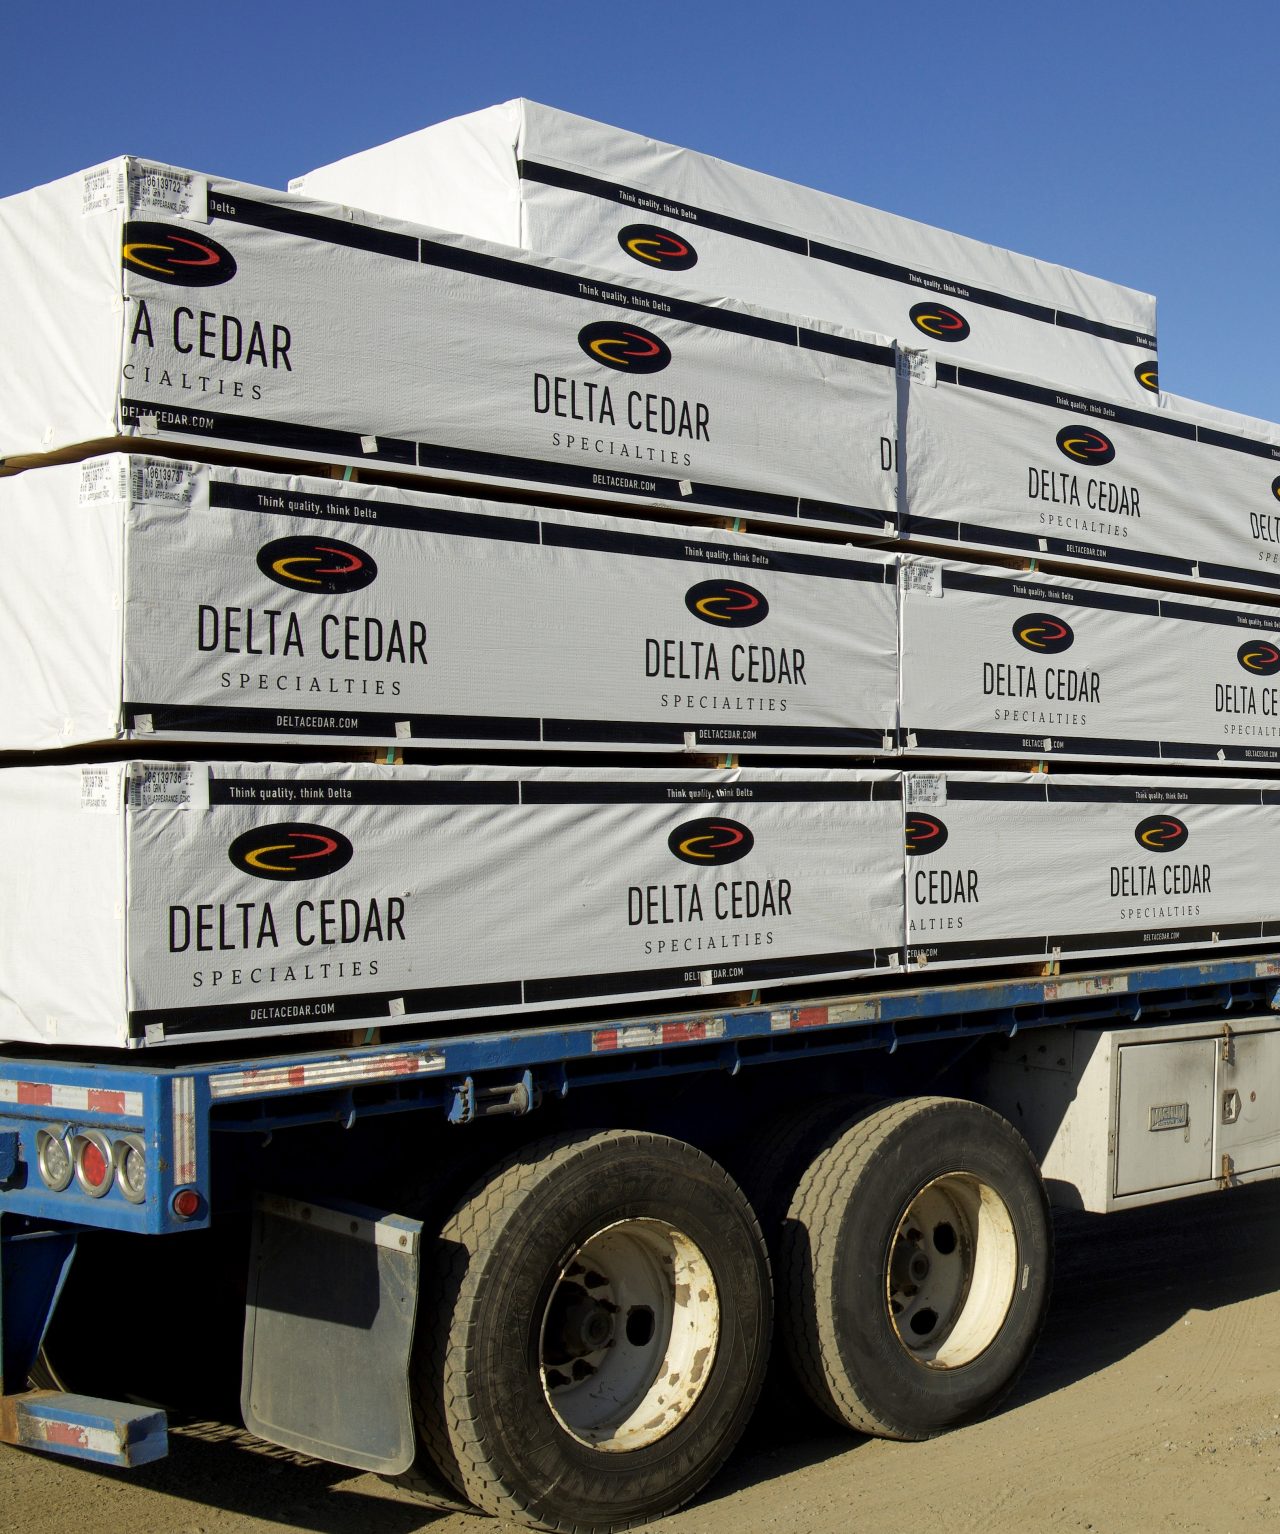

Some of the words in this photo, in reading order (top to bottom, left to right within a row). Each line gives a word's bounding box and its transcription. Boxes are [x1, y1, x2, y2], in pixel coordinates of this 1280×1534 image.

[210, 200, 236, 215] Delta
[619, 190, 636, 202] Think
[638, 198, 661, 211] quality,
[664, 205, 679, 216] think
[681, 208, 697, 220] Delta
[909, 274, 922, 284] Think
[923, 279, 942, 291] quality,
[943, 283, 955, 293] think
[957, 287, 969, 297] Delta
[579, 283, 599, 296] Think
[602, 289, 629, 303] quality,
[631, 298, 650, 308] think
[652, 300, 671, 312] Delta
[173, 307, 292, 371] CEDAR
[1136, 336, 1148, 344] Think
[534, 373, 615, 425] DELTA
[628, 391, 709, 441] CEDAR
[1056, 396, 1069, 406] Think
[1070, 401, 1088, 412] quality,
[1090, 405, 1101, 413] think
[1103, 409, 1115, 417] Delta
[552, 432, 691, 466] SPECIALTIES
[1271, 449, 1280, 458] Think
[593, 474, 656, 491] DELTACEDAR.COM
[1028, 467, 1080, 506] DELTA
[1087, 478, 1140, 517] CEDAR
[155, 490, 180, 501] APPEARANCE
[258, 495, 284, 508] Think
[289, 498, 323, 515] quality,
[327, 504, 350, 516] think
[354, 507, 377, 519] Delta
[1040, 513, 1128, 537] SPECIALTIES
[685, 547, 704, 556] Think
[706, 550, 730, 561] quality,
[733, 553, 750, 562] think
[752, 555, 768, 565] Delta
[1067, 544, 1106, 558] DELTACEDAR.COM
[1013, 585, 1027, 594] Think
[1029, 587, 1046, 598] quality,
[1048, 589, 1060, 599] think
[1061, 592, 1073, 600] Delta
[1237, 616, 1247, 624] Think
[198, 605, 304, 657] DELTA
[321, 614, 427, 664] CEDAR
[646, 638, 720, 680] DELTA
[732, 644, 806, 685] CEDAR
[221, 673, 401, 695] SPECIALTIES
[983, 662, 1037, 698] DELTA
[1045, 668, 1100, 703] CEDAR
[661, 694, 787, 711] SPECIALTIES
[1216, 684, 1256, 715] DELTA
[277, 716, 358, 728] DELTACEDAR.COM
[995, 709, 1086, 726] SPECIALTIES
[699, 729, 756, 739] DELTACEDAR.COM
[1245, 750, 1277, 758] DELTACEDAR.COM
[153, 795, 178, 804] APPEARANCE
[230, 787, 255, 798] Think
[260, 787, 297, 800] quality,
[300, 787, 324, 798] think
[328, 788, 352, 798] Delta
[667, 789, 686, 798] Think
[689, 789, 715, 799] quality,
[716, 789, 733, 797] think
[736, 788, 752, 797] Delta
[1136, 792, 1147, 800] Think
[1148, 793, 1164, 801] quality,
[1165, 792, 1176, 800] think
[915, 870, 978, 904] CEDAR
[1111, 866, 1156, 897] DELTA
[1163, 864, 1211, 894] CEDAR
[628, 883, 703, 925] DELTA
[715, 879, 791, 920] CEDAR
[1121, 905, 1200, 919] SPECIALTIES
[169, 902, 278, 952] DELTA
[295, 897, 405, 946] CEDAR
[645, 932, 773, 954] SPECIALTIES
[1144, 932, 1179, 941] DELTACEDAR.COM
[193, 961, 379, 987] SPECIALTIES
[251, 1003, 335, 1019] DELTACEDAR.COM
